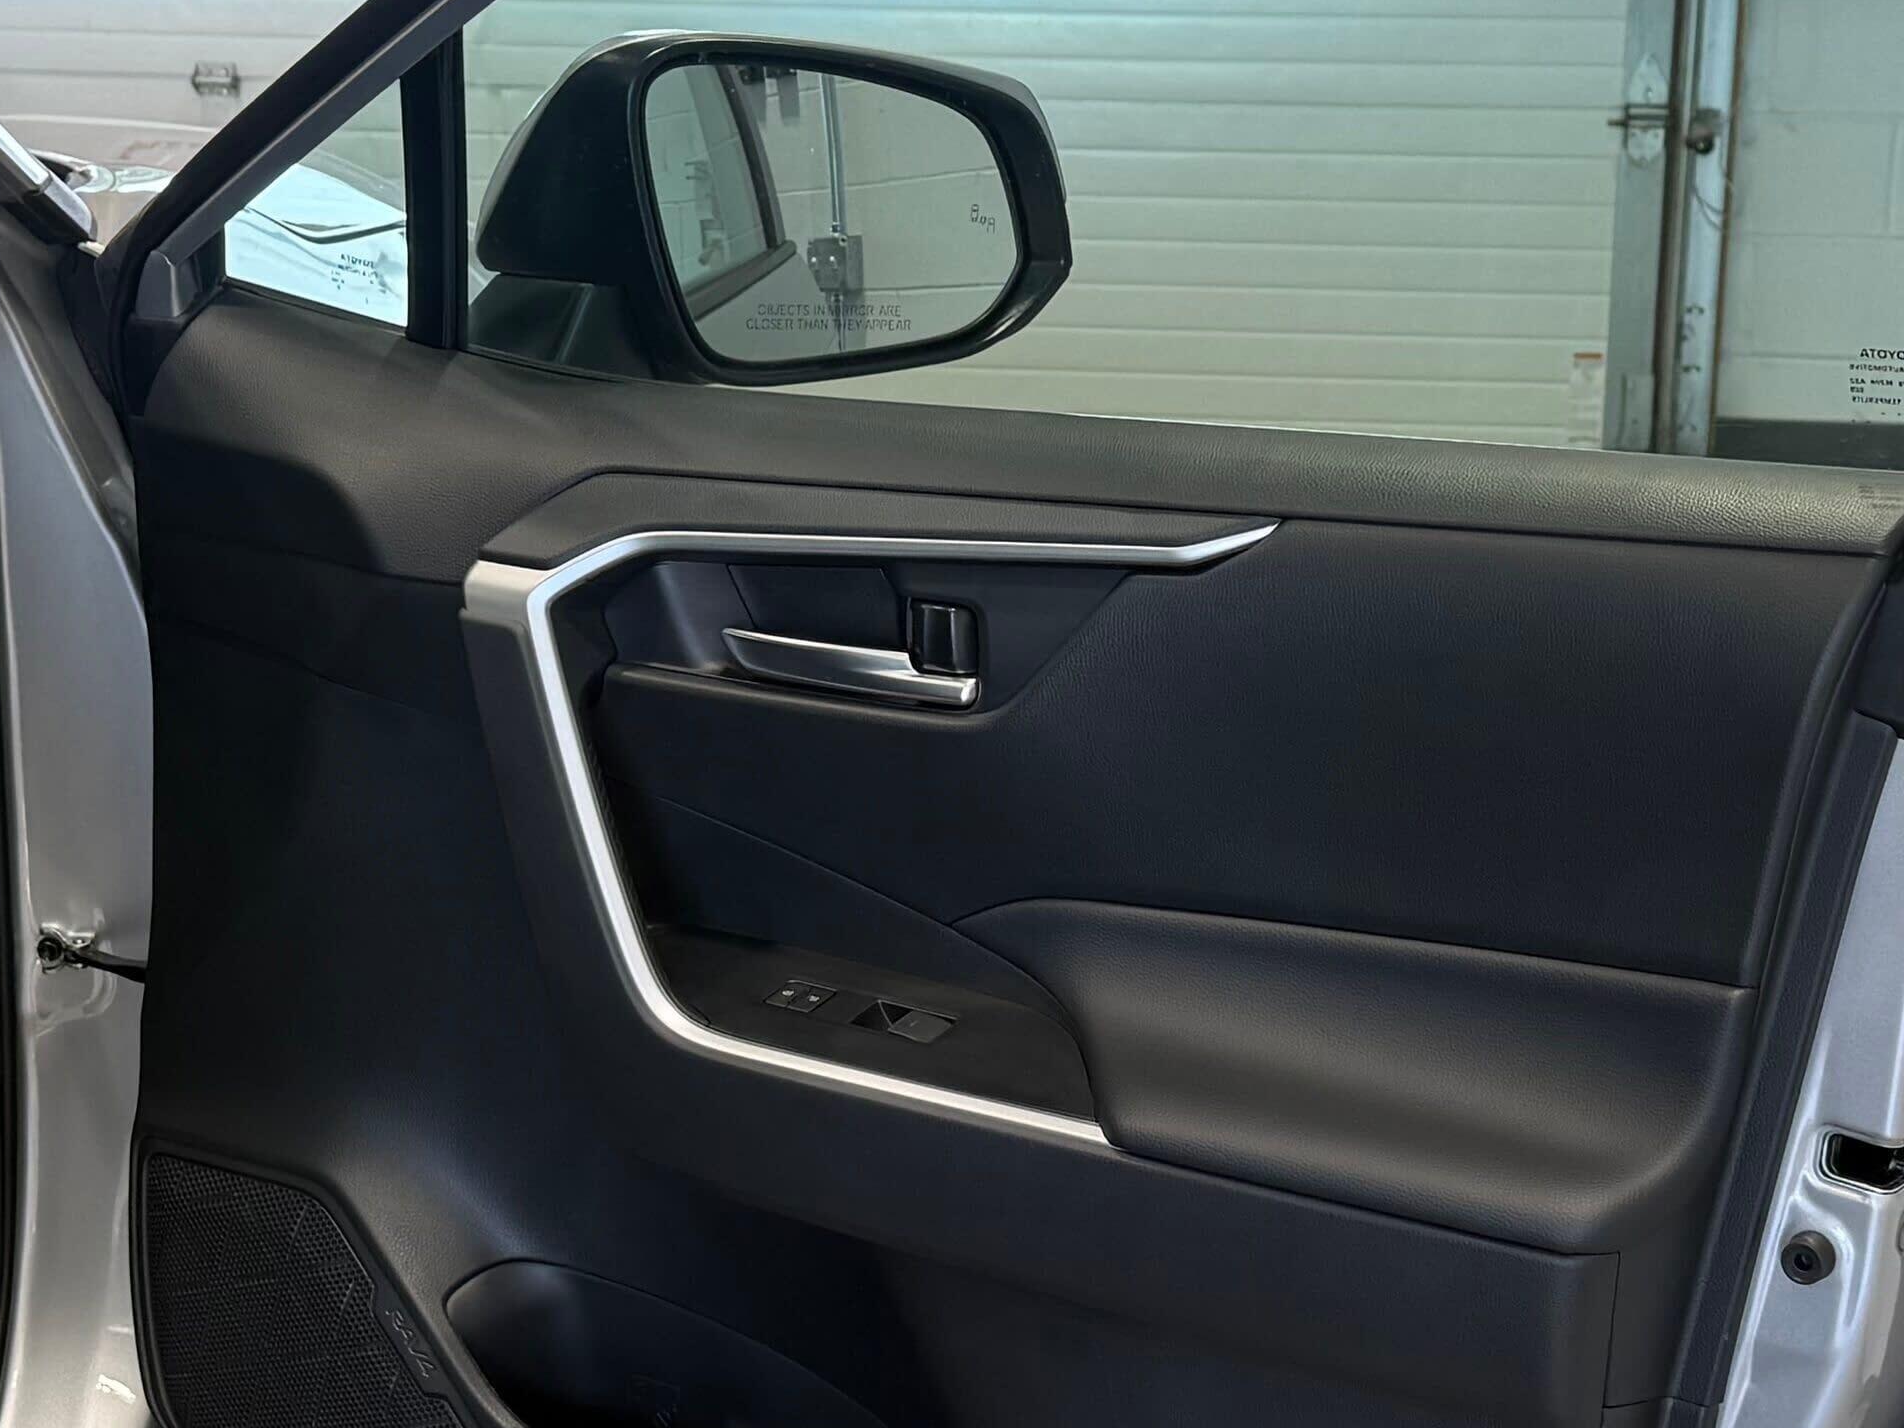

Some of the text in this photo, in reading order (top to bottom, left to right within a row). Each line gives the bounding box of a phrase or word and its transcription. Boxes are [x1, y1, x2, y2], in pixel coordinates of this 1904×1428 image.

[757, 303, 901, 317] OBJECTS IN MIRROR ARE
[746, 318, 911, 332] CLOSER THAN THEY APPEAR
[385, 1310, 434, 1379] RAV4
